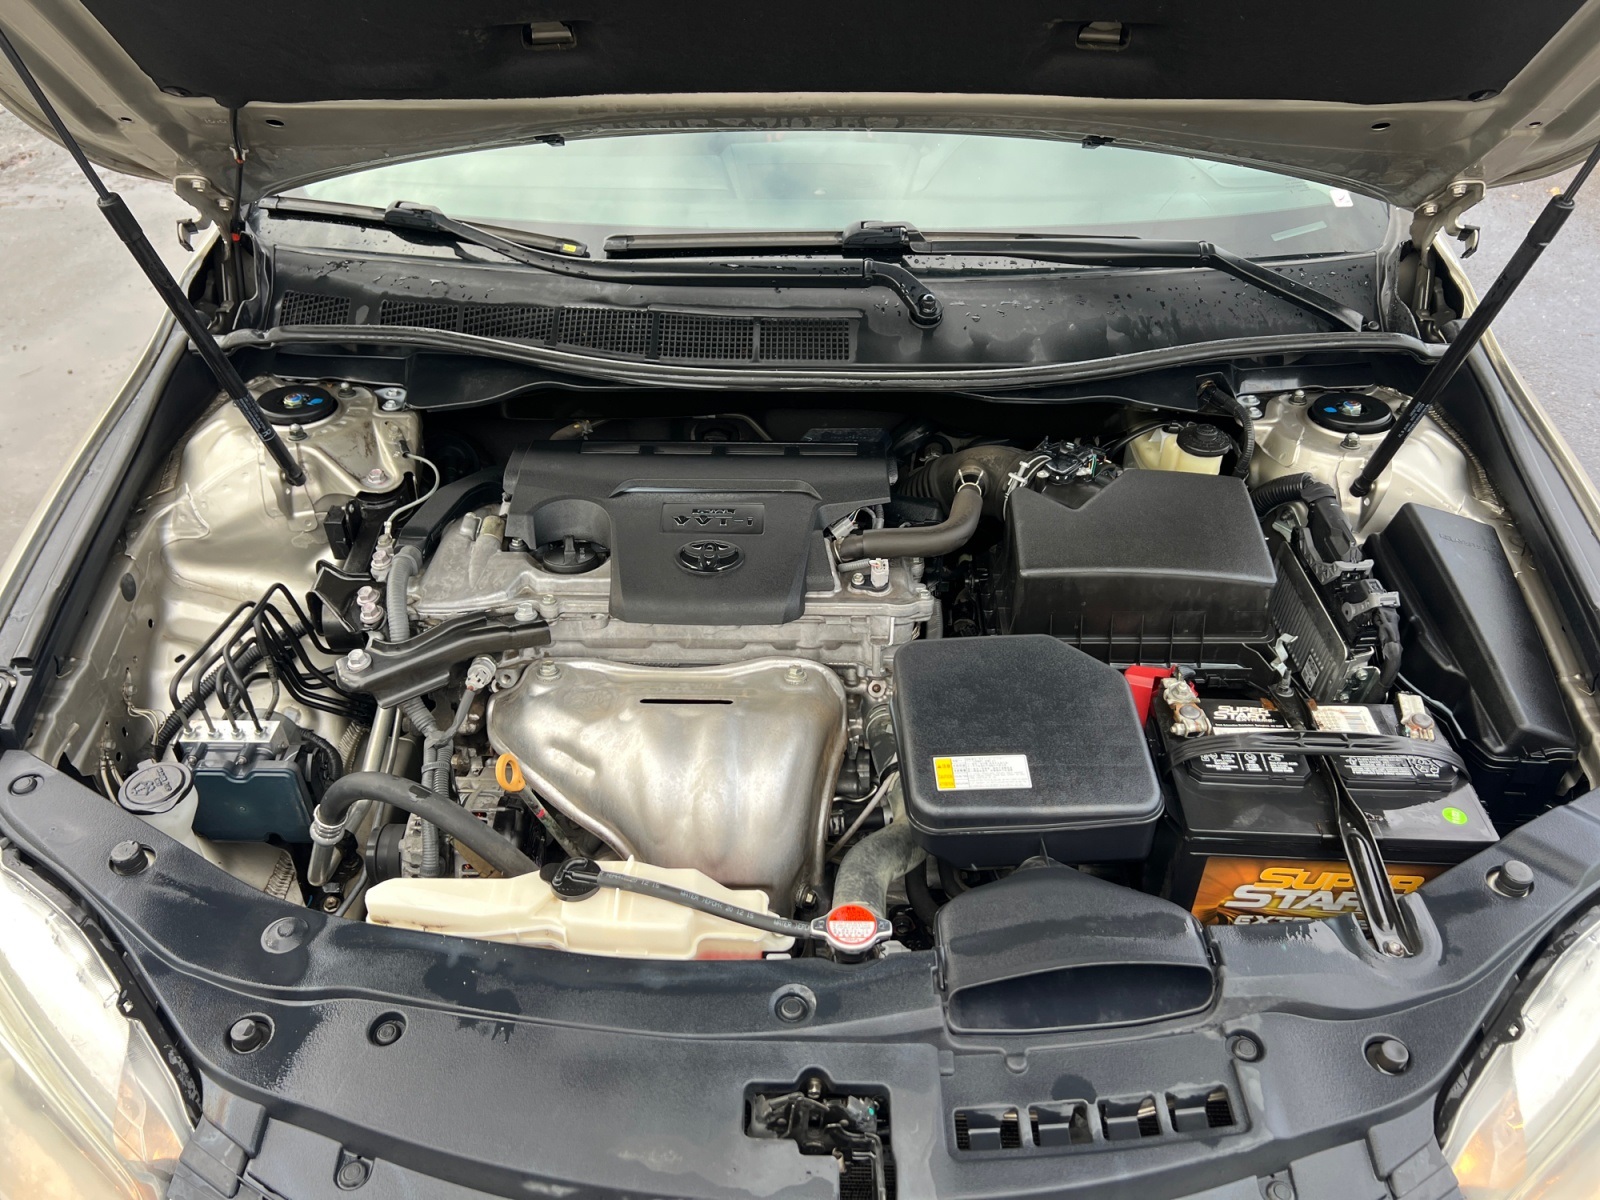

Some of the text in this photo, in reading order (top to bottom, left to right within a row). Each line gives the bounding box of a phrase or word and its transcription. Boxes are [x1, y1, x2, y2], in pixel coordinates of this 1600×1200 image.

[673, 515, 754, 527] VVT-i
[1213, 710, 1271, 720] START
[1217, 705, 1270, 714] SUPER
[1253, 867, 1425, 894] SUPR
